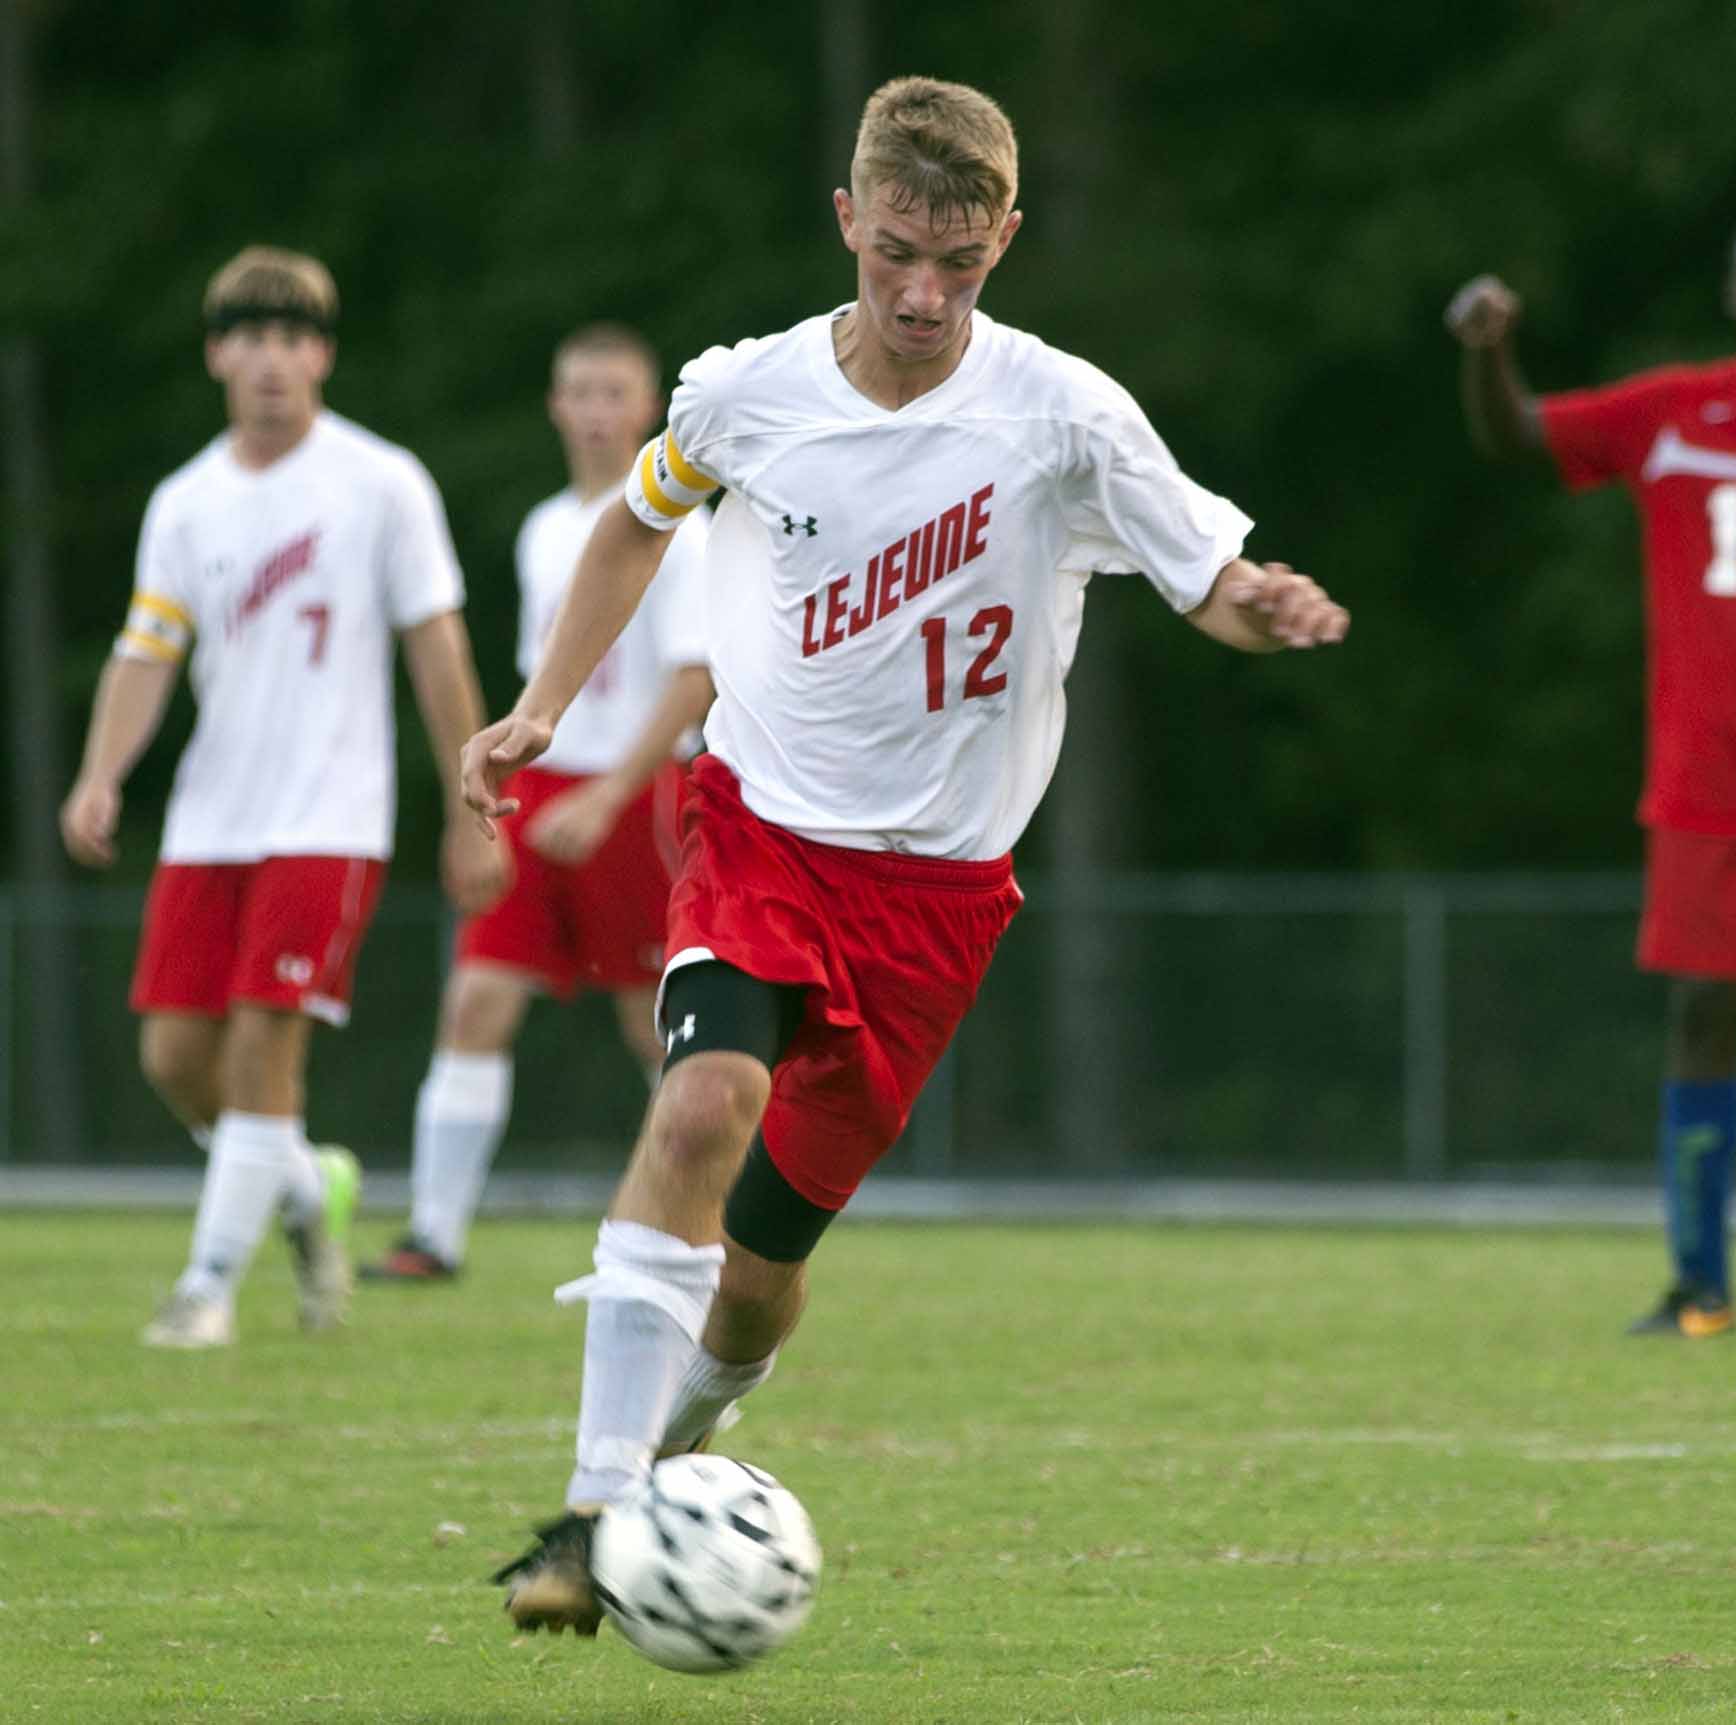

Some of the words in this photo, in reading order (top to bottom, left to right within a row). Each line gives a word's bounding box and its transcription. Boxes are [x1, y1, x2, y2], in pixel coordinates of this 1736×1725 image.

[802, 482, 994, 658] LEJEUNE
[295, 603, 330, 666] 7
[921, 604, 1013, 713] 12
